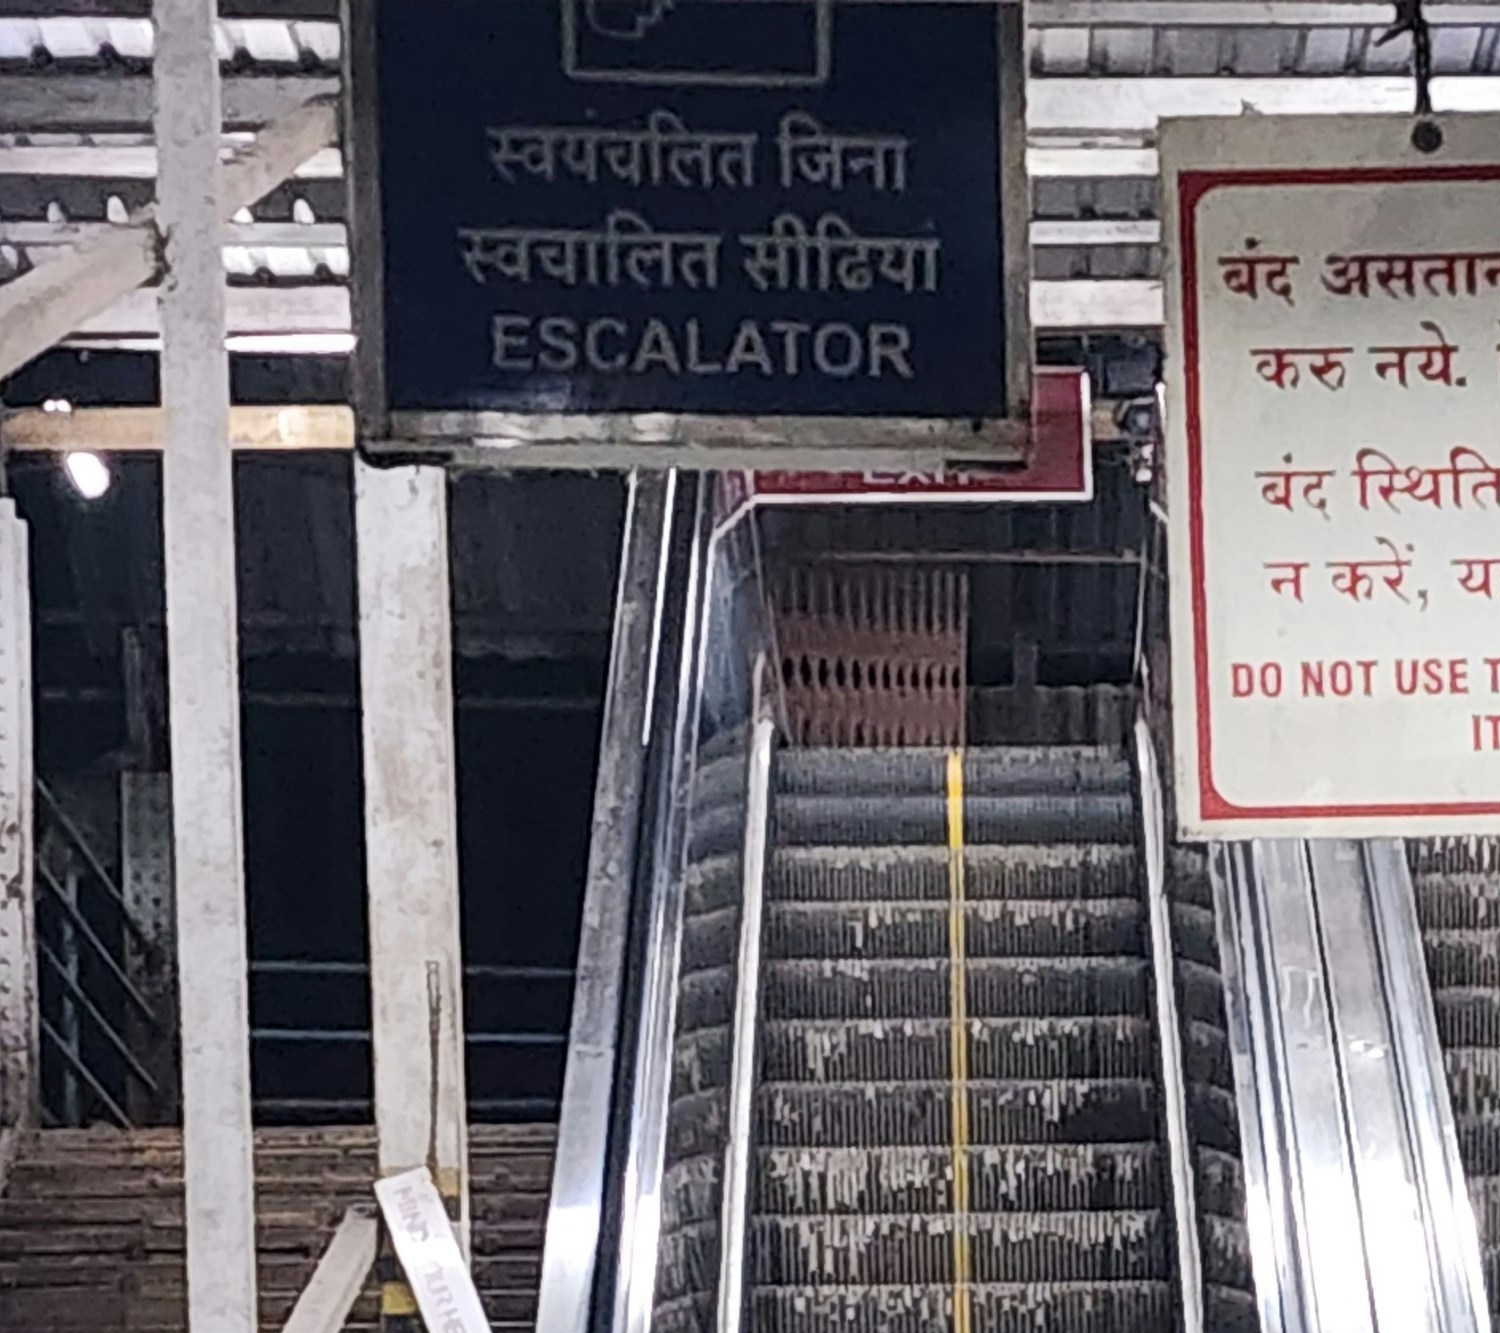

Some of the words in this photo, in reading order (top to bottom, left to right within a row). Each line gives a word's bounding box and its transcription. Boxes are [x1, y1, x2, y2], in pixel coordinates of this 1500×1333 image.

[485, 108, 757, 186] स्वयंचलित
[778, 111, 909, 191] जिना
[457, 209, 722, 288] स्वचालित
[1217, 237, 1300, 306] बंद
[490, 314, 914, 380] ESCALATOR
[1368, 321, 1467, 388] नये.
[1255, 452, 1336, 520] बंद
[1264, 562, 1310, 603] न
[1325, 537, 1428, 611] करें,
[1231, 662, 1282, 698] DO
[1301, 660, 1378, 697] NOT
[1395, 658, 1469, 695] USE
